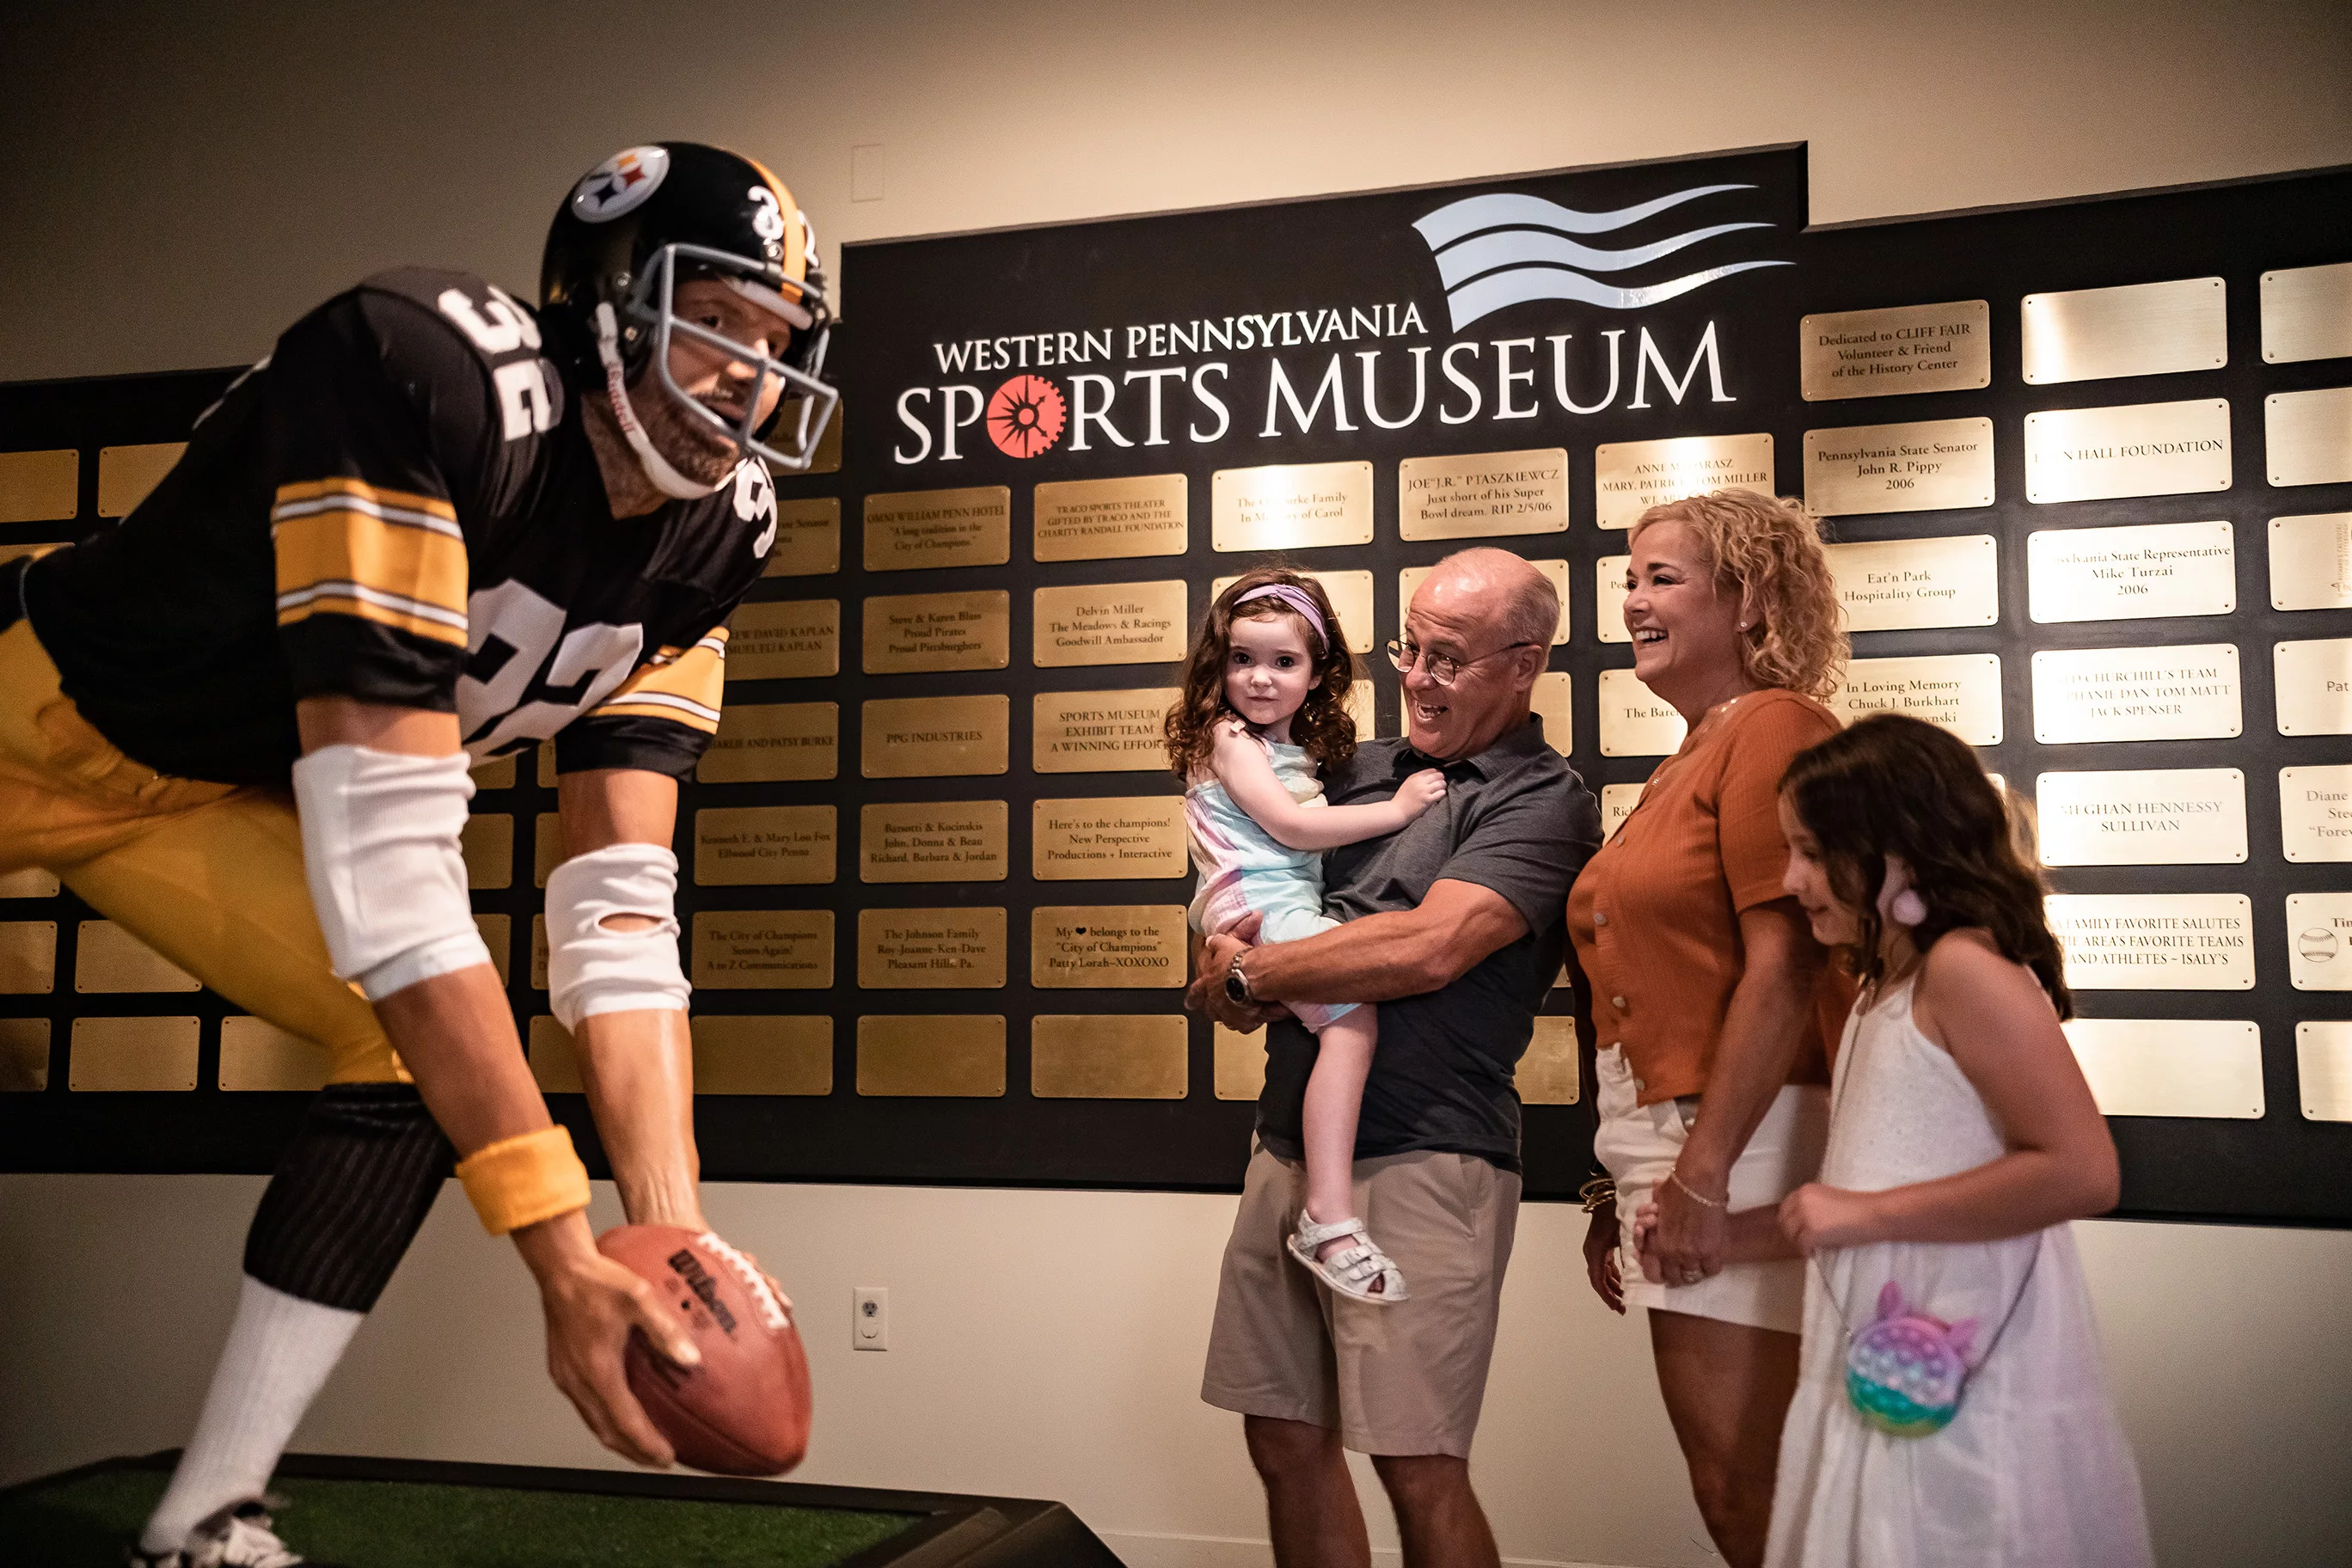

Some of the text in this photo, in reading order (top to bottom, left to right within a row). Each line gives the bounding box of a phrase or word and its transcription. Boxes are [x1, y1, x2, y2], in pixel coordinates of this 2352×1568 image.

[934, 301, 1428, 375] WESTERN PENNSYLVANIA
[1819, 323, 1972, 346] Dedicated to CLIFF FAIR
[1838, 341, 1951, 361] Volunteer & Friend
[1831, 359, 1959, 377] of the History Center
[1258, 321, 1737, 438] MUSEUM
[1818, 443, 1979, 462] Pennsylvania State Senator
[2078, 447, 2116, 460] HALL
[2121, 439, 2224, 458] FOUNDATION
[1634, 462, 1665, 475] ANNE
[1857, 462, 1943, 478] John R. Pippy
[1466, 469, 1559, 486] PTASZKIEWCZ
[1724, 472, 1767, 484] MILLER
[1885, 479, 1915, 490] 2006
[1238, 497, 1255, 508] The
[1313, 492, 1347, 505] Family
[1427, 487, 1545, 506] Just short of his Super
[1089, 502, 1121, 511] SPORTS
[1124, 499, 1166, 510] THEATER
[1421, 500, 1553, 520] Bowl dream. RIP 2/5/06
[1047, 517, 1081, 526] GIFTED
[1083, 516, 1093, 524] BY
[1130, 512, 1150, 521] AND
[1154, 510, 1173, 519] THE
[1240, 513, 1252, 523] In
[1302, 508, 1312, 519] of
[1315, 506, 1343, 518] Carol
[1038, 529, 1079, 538] CHARITY
[1124, 521, 1184, 532] FOUNDATION
[2111, 544, 2232, 562] State Representative
[1867, 570, 1932, 585] Eat'n Park
[2092, 564, 2174, 580] Mike Turzai
[1845, 588, 1956, 603] Hospitality Group
[2117, 584, 2149, 596] 2006
[1076, 603, 1144, 617] Delvin Miller
[1050, 618, 1172, 634] The Meadows & Racings
[1056, 633, 1165, 647] Goodwill Ambassador
[889, 643, 916, 653] Proud
[2085, 670, 2174, 683] CHURCHILL'S
[2180, 668, 2218, 679] TEAM
[1846, 679, 1962, 695] In Loving Memory
[2120, 684, 2232, 699] DAN TOM MATT
[2325, 681, 2349, 693] Pat
[1848, 696, 1960, 710] Chuck J. Burkhart
[1059, 708, 1161, 723] SPORTS MUSEUM
[1624, 707, 1647, 720] The
[2091, 704, 2183, 718] JACK SPENSER
[911, 730, 983, 744] INDUSTRIES
[1066, 724, 1154, 738] EXHIBIT TEAM
[1049, 742, 1060, 753] A
[1062, 739, 1120, 752] WINNING
[2306, 789, 2349, 801] Diane
[2060, 800, 2224, 816] MEGHAN HENNESSY
[924, 822, 934, 832] &
[1048, 817, 1171, 831] Here's to the champions!
[2100, 819, 2180, 833] SULLIVAN
[912, 836, 956, 848] Donna &
[1069, 832, 1150, 847] New Perspective
[912, 850, 997, 863] Barbara & Jordan
[1048, 848, 1173, 861] Productions Interactive
[2066, 917, 2241, 929] FAMILY FAVORITE SALUTES
[752, 930, 762, 940] of
[885, 928, 980, 941] The Johnson Family
[1056, 926, 1160, 940] My belongs to the
[1086, 940, 1098, 952] of
[2083, 935, 2245, 947] AREA'S FAVORITE TEAMS
[887, 958, 928, 969] Pleasant
[1049, 958, 1076, 971] Patty
[2069, 952, 2229, 965] AND ATHLETES ISALY'S
